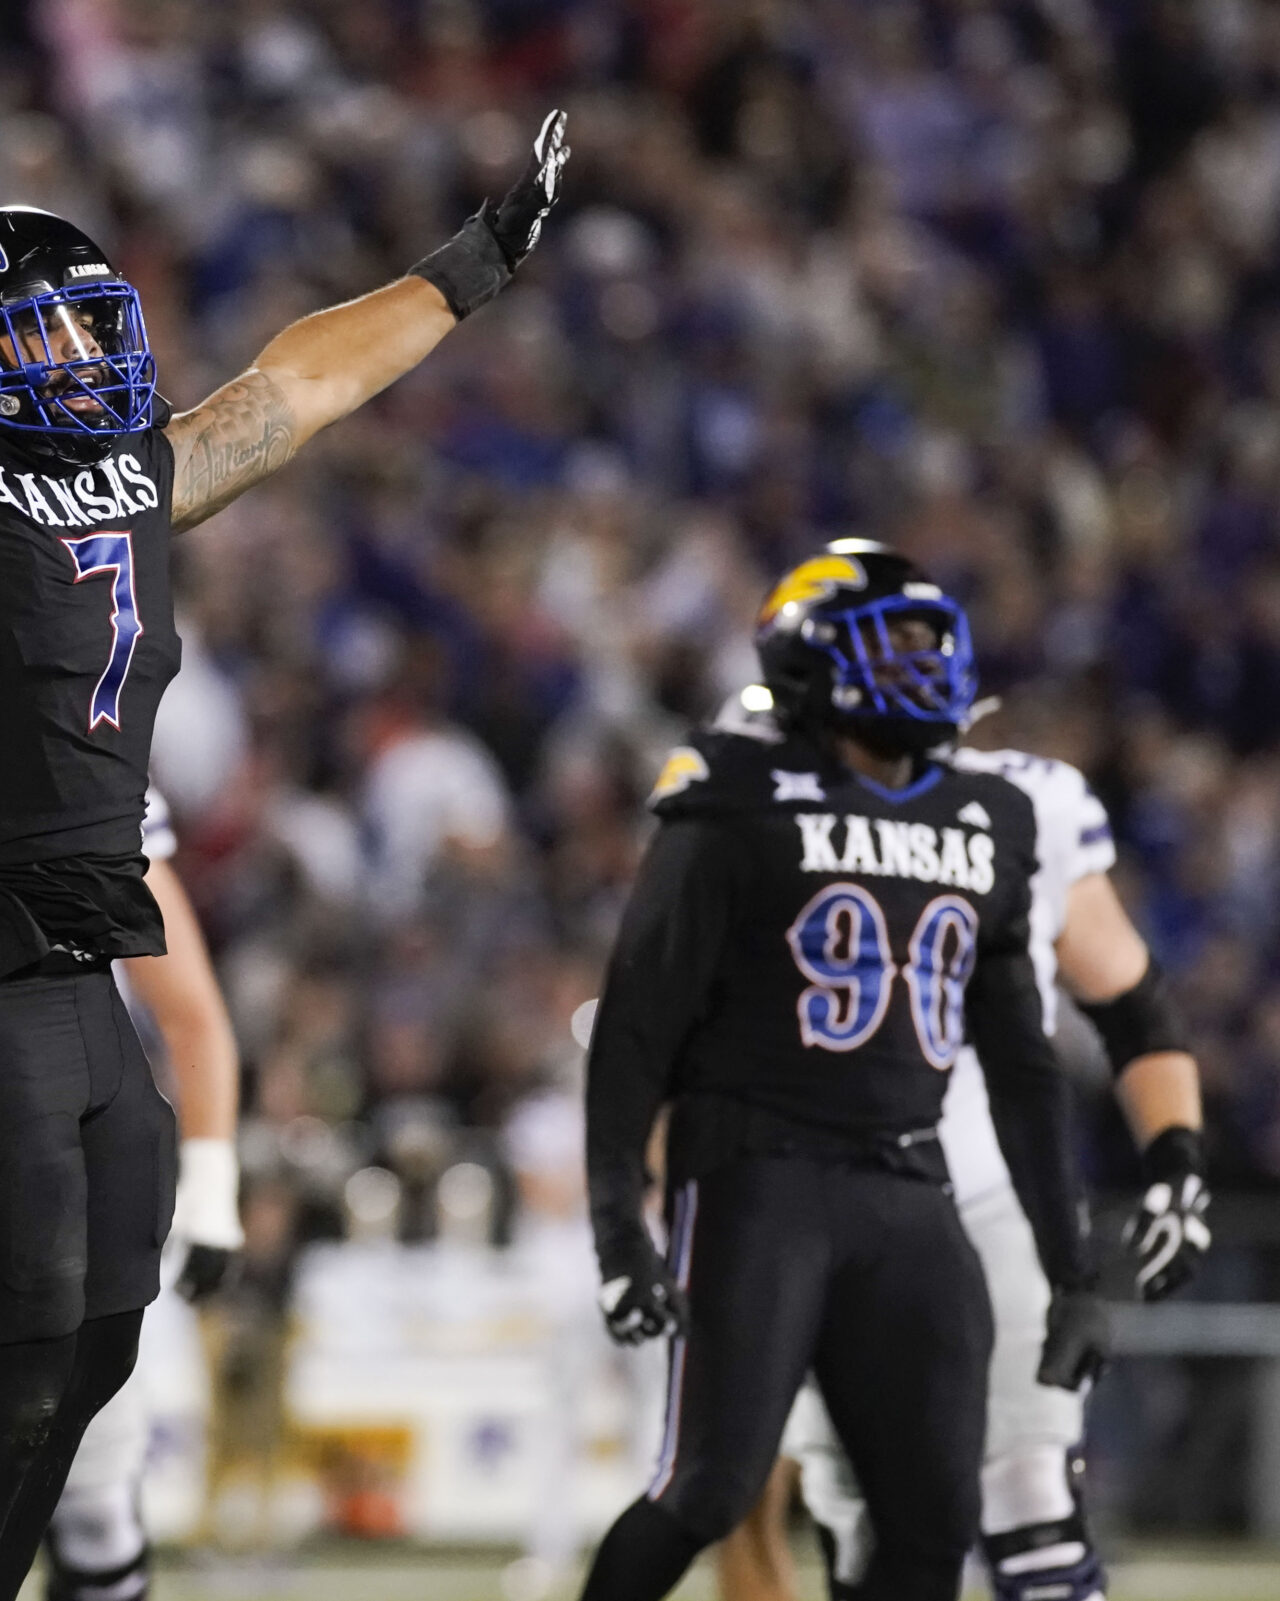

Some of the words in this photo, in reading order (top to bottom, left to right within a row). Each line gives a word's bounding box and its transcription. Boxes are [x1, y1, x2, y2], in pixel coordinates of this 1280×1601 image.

[57, 530, 144, 734] 7
[795, 813, 995, 895] KANSAS
[787, 882, 979, 1070] 90
